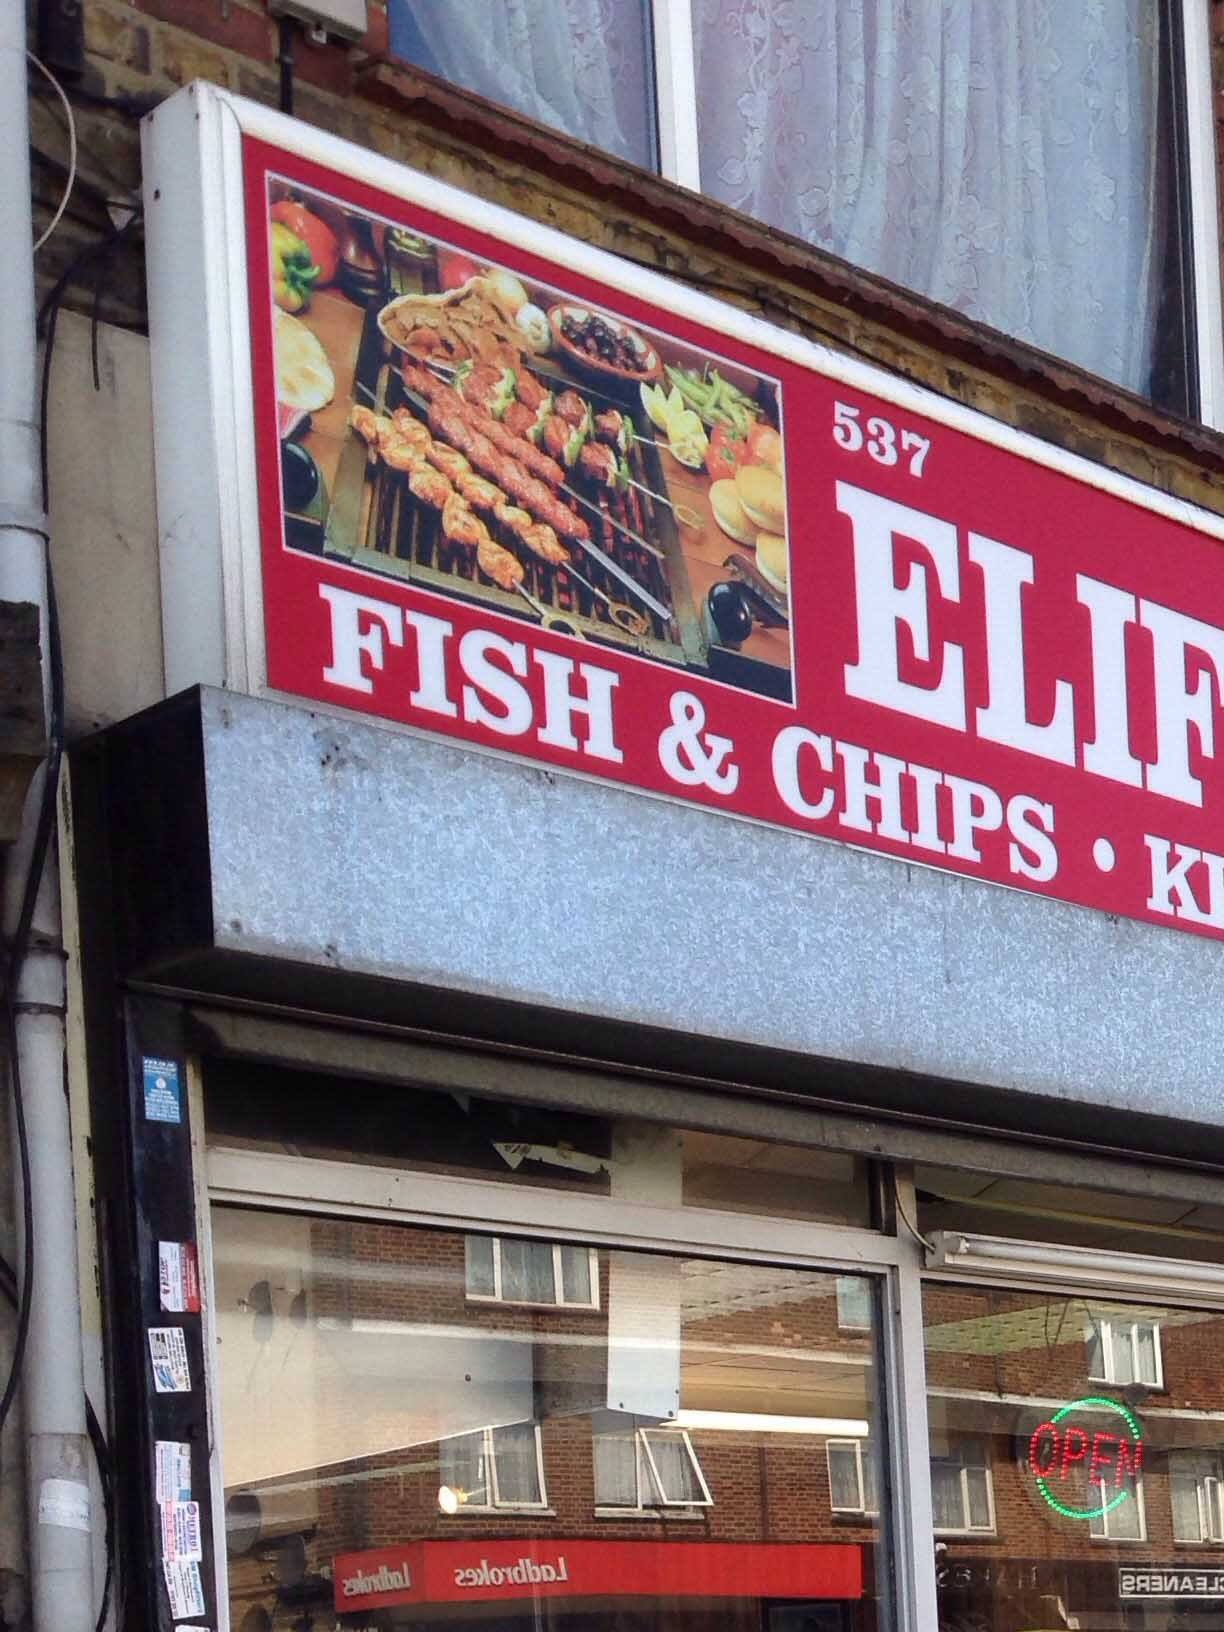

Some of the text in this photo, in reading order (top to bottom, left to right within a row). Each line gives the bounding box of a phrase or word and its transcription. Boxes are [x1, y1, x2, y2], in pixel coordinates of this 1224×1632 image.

[832, 401, 930, 478] 537
[318, 583, 623, 763] FISH
[658, 692, 739, 796] &
[771, 727, 1058, 882] CHIPS
[1029, 1422, 1143, 1488] OPEN
